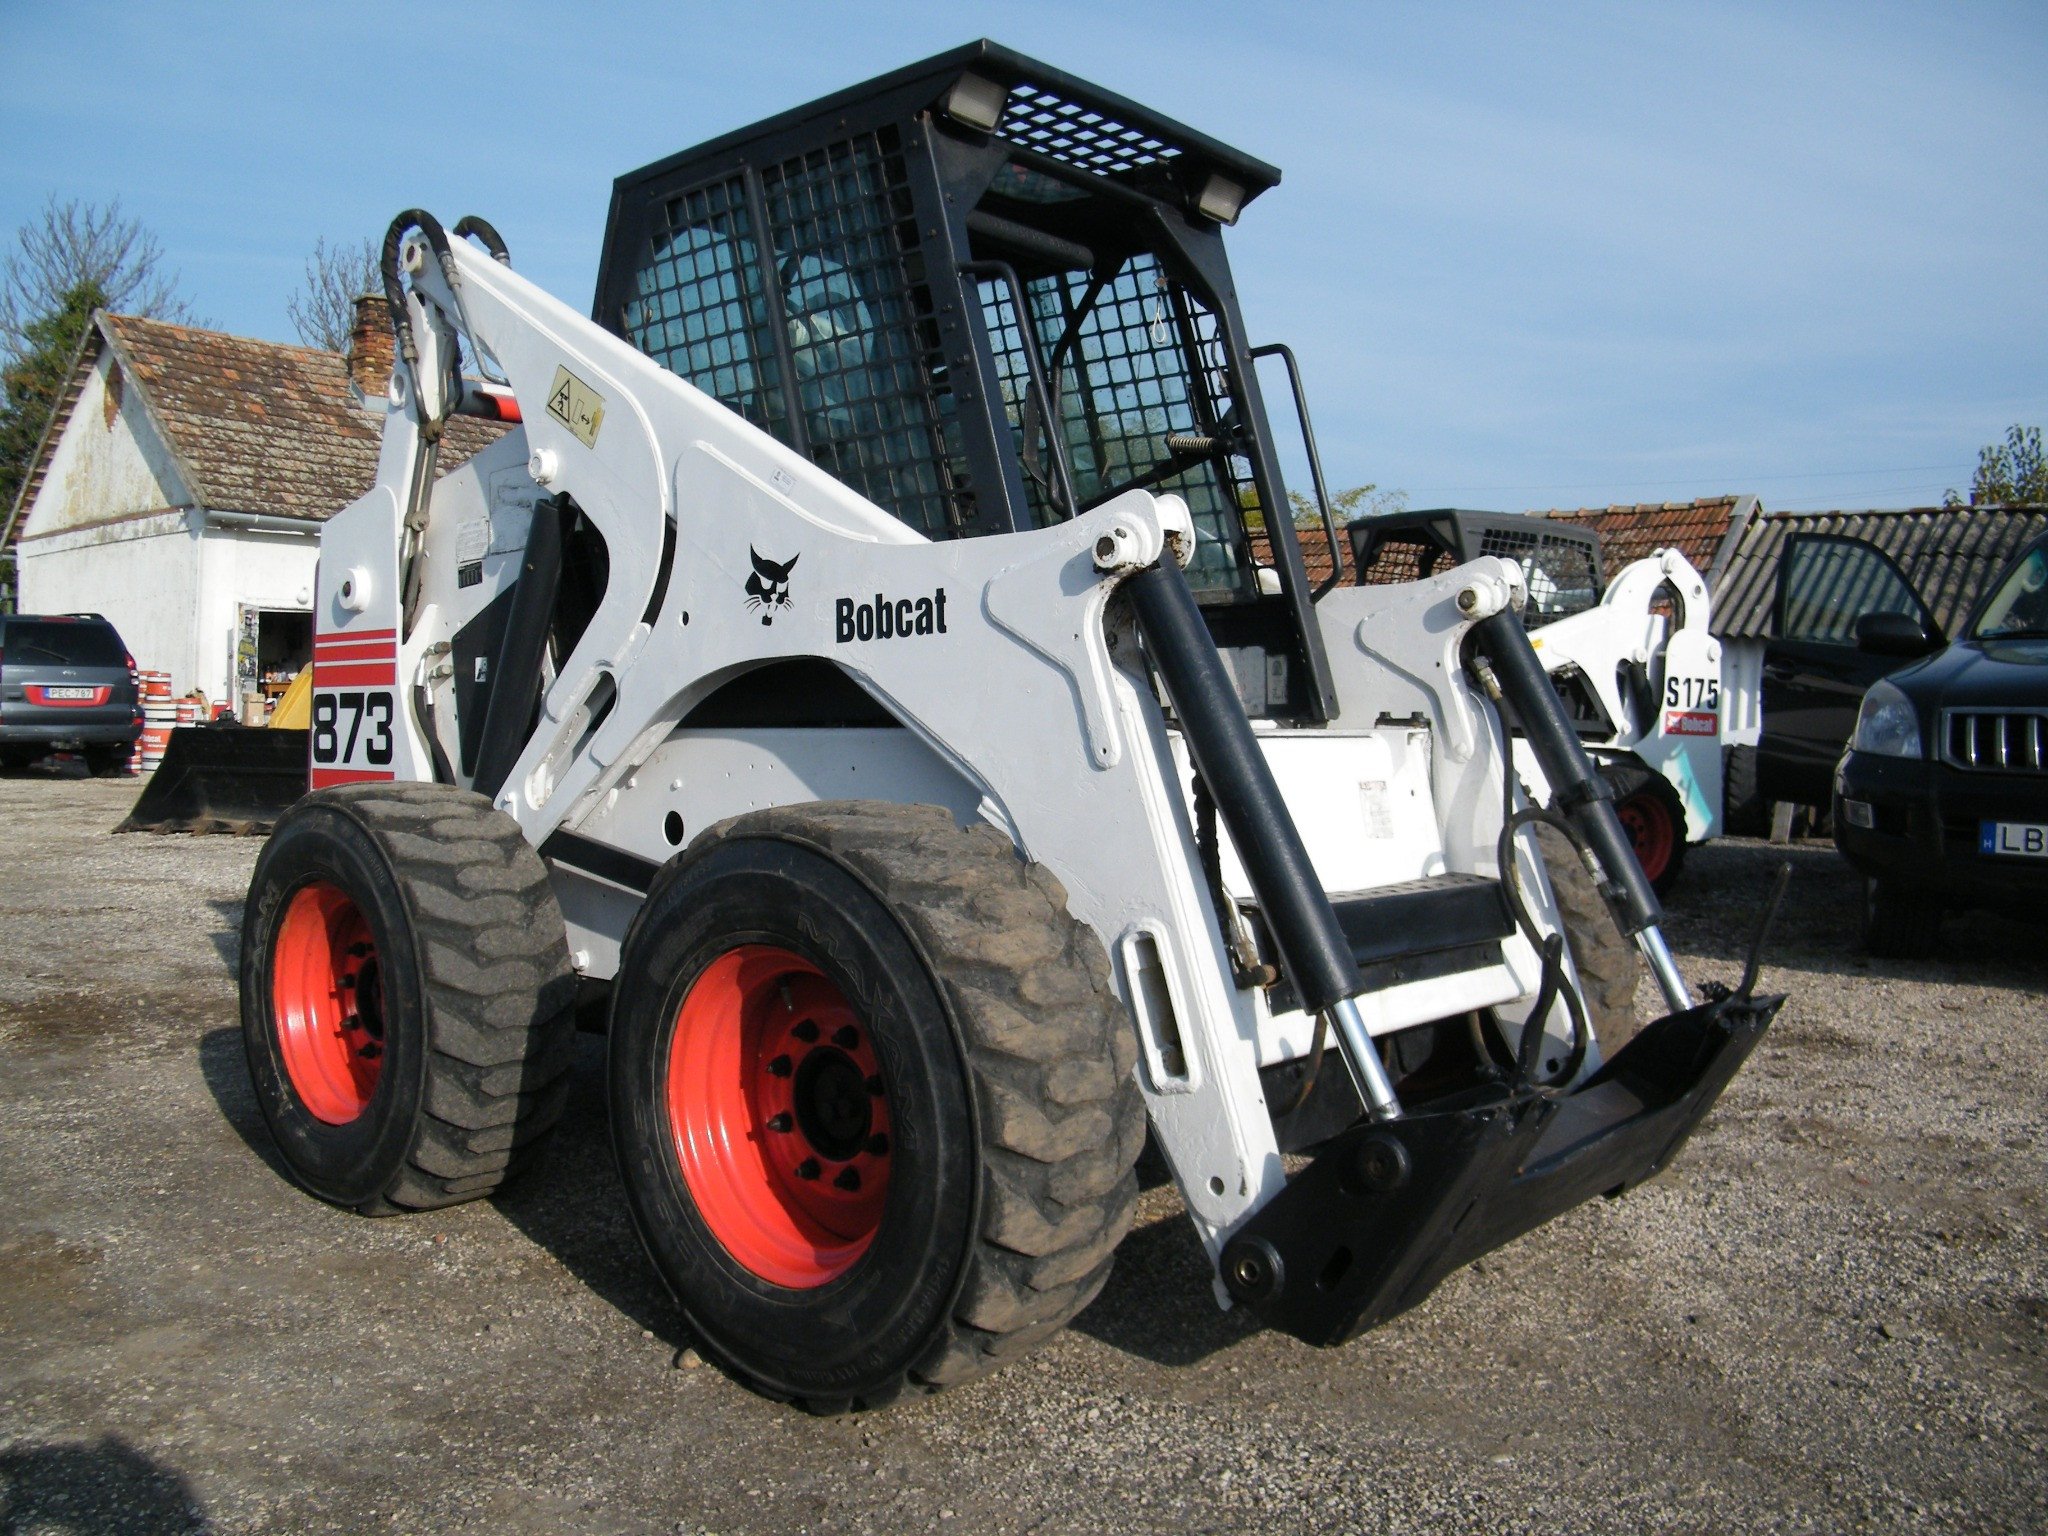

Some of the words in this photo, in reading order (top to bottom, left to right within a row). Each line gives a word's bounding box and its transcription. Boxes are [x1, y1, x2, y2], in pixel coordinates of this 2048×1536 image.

[836, 588, 947, 643] Bobcat
[1667, 677, 1718, 709] S175
[313, 692, 393, 765] 873
[1983, 839, 1992, 848] H
